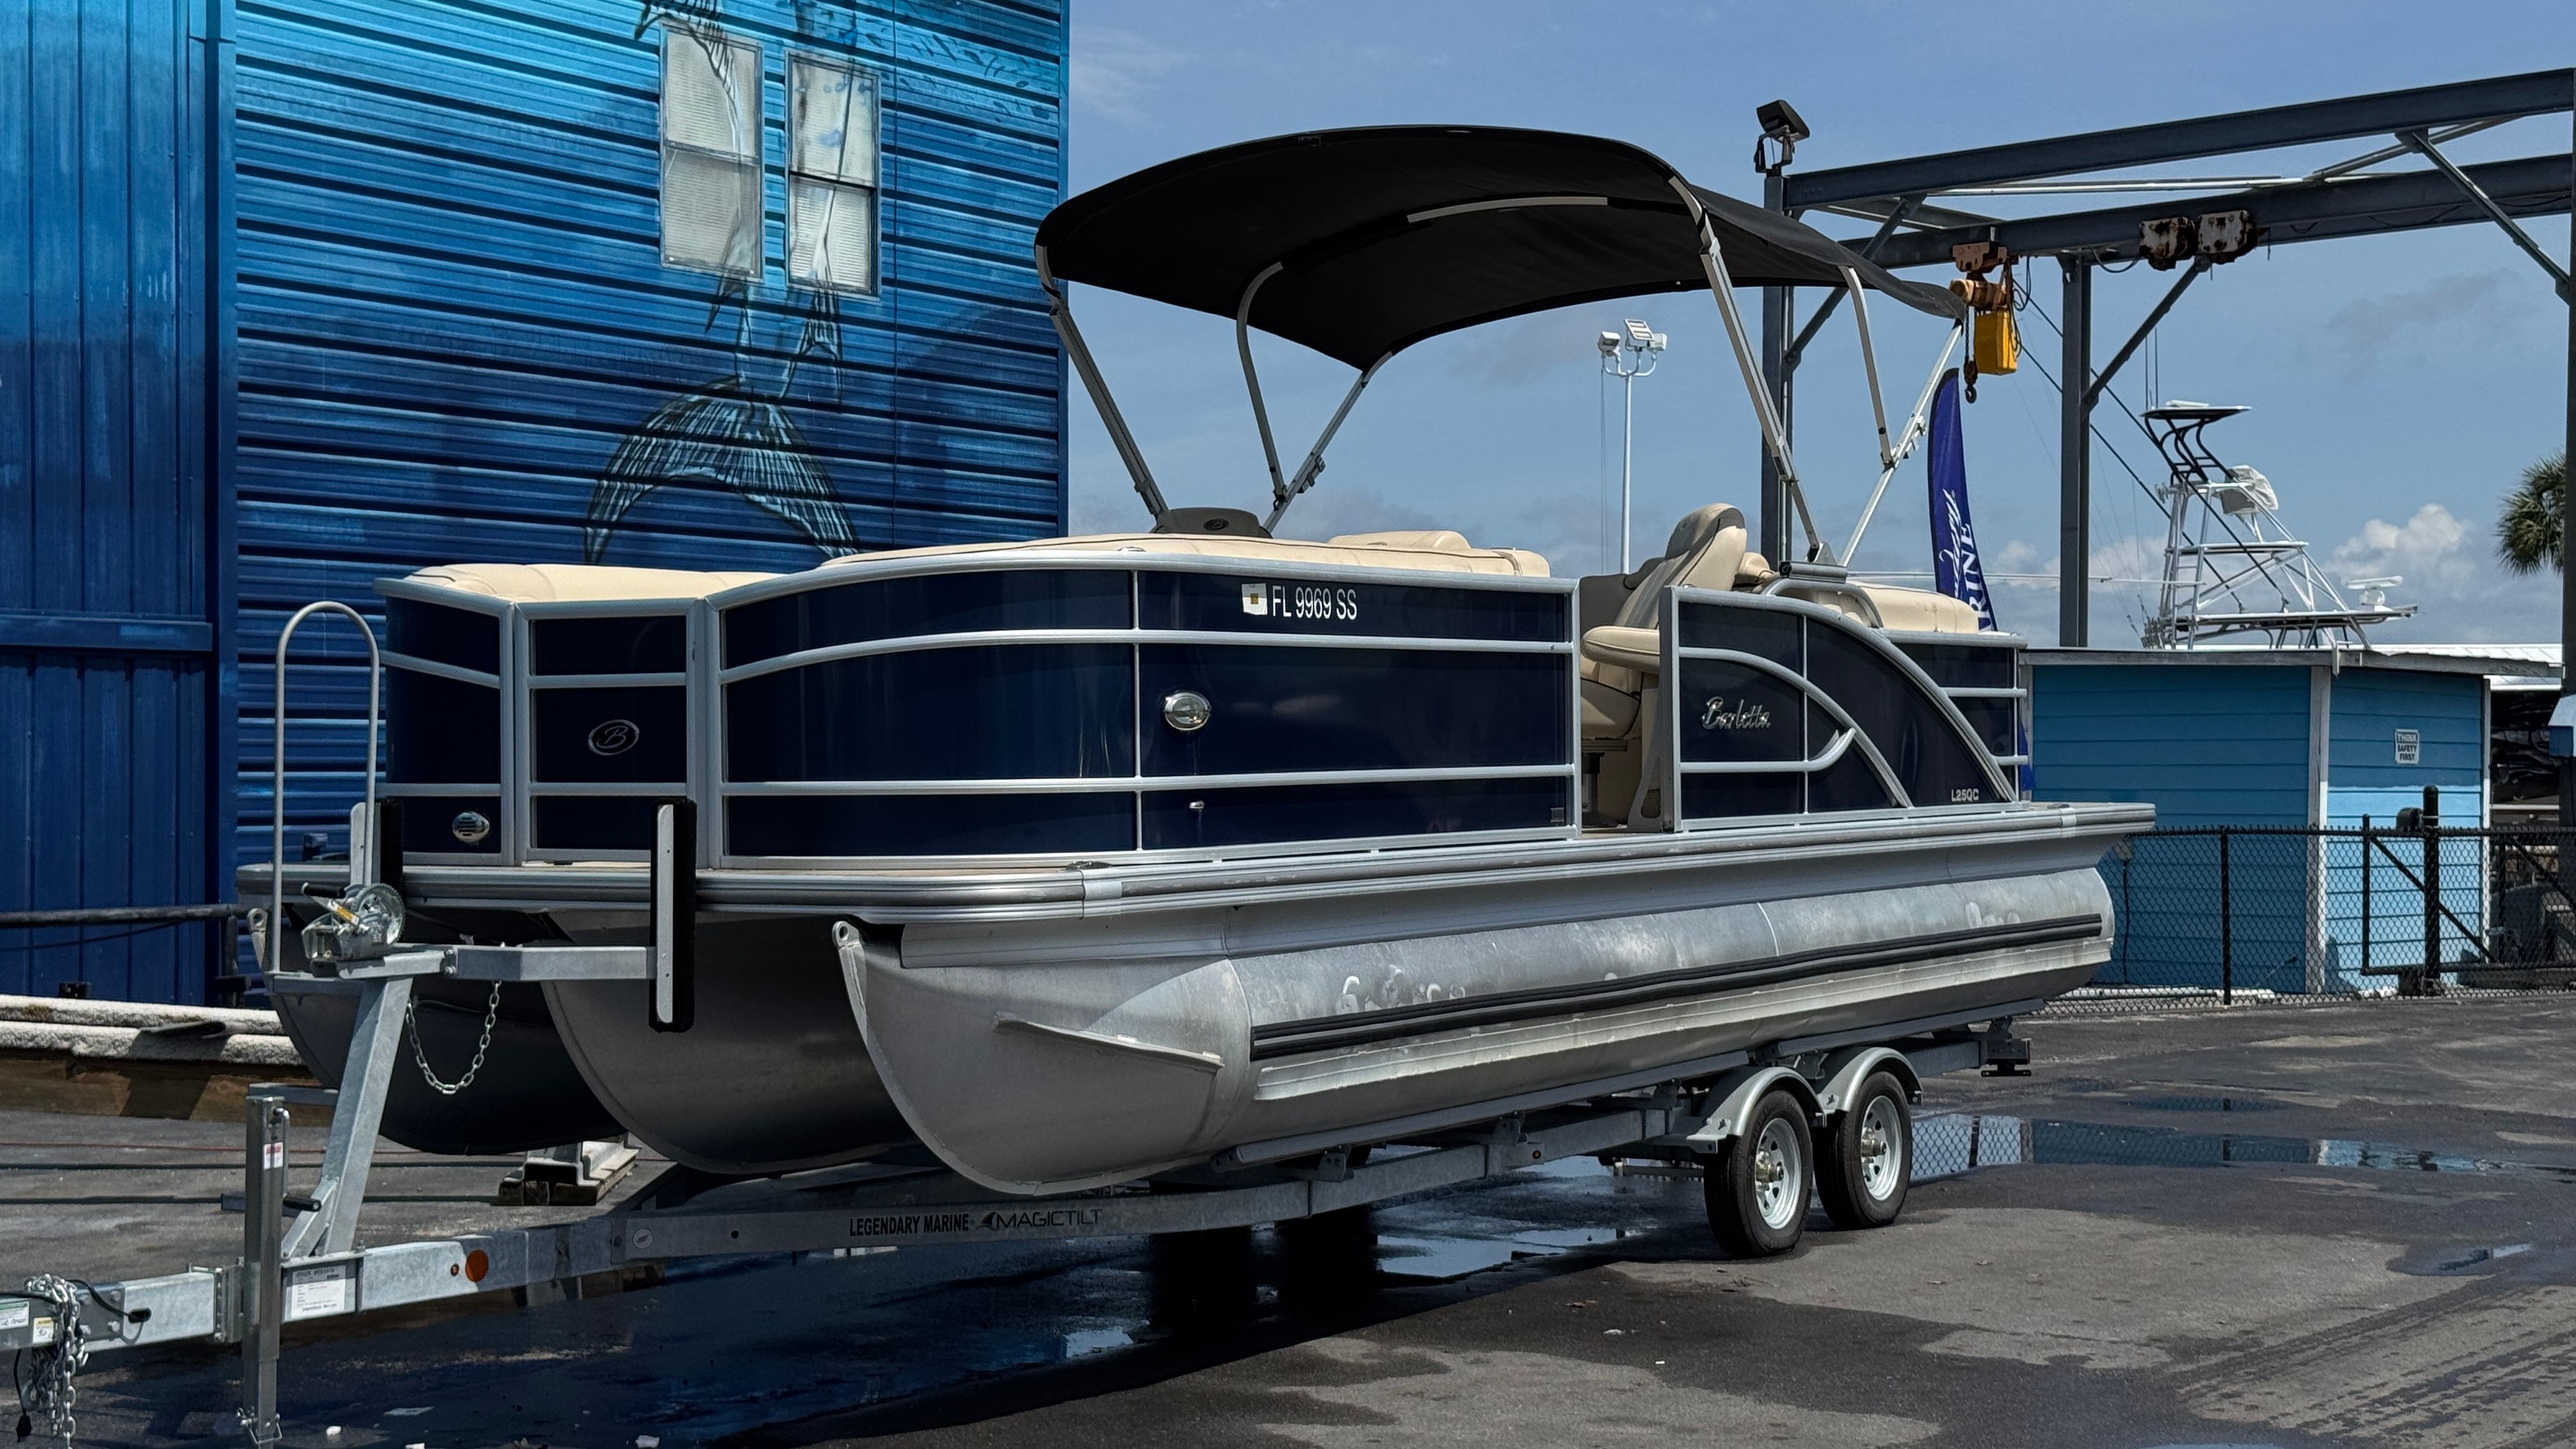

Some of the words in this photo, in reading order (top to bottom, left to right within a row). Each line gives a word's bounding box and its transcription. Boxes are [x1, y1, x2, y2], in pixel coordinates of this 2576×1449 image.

[1272, 585, 1292, 617] FL
[1295, 586, 1332, 619] 9969
[1336, 588, 1358, 620] SS
[1701, 696, 1771, 730] Barletta
[1951, 788, 1980, 802] L25QC
[849, 1215, 920, 1236] LEGENDARY
[923, 1214, 970, 1232] MARINE
[995, 1209, 1103, 1230] MAGICTILT
